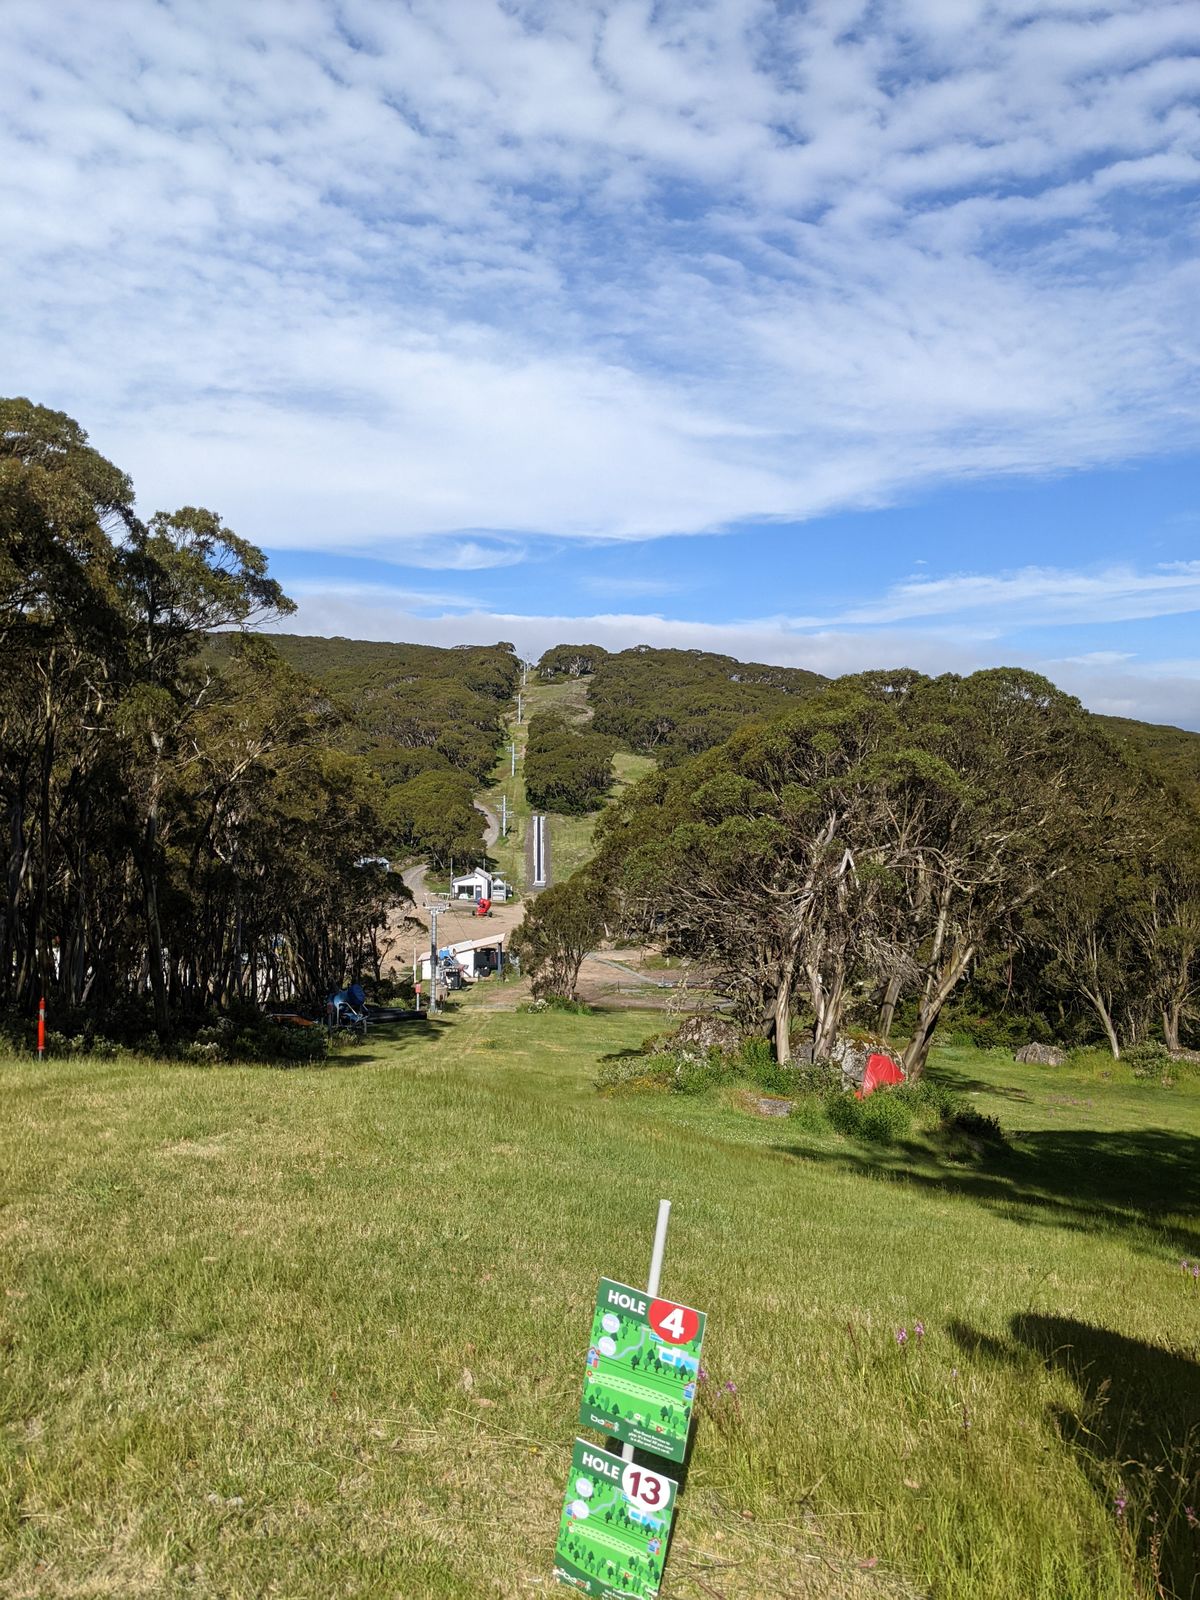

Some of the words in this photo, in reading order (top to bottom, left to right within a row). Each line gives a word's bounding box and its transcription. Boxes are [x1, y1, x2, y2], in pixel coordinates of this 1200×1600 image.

[608, 1290, 646, 1315] HOLE
[659, 1308, 684, 1339] 4
[582, 1452, 620, 1479] HOLE
[630, 1472, 661, 1505] 13
